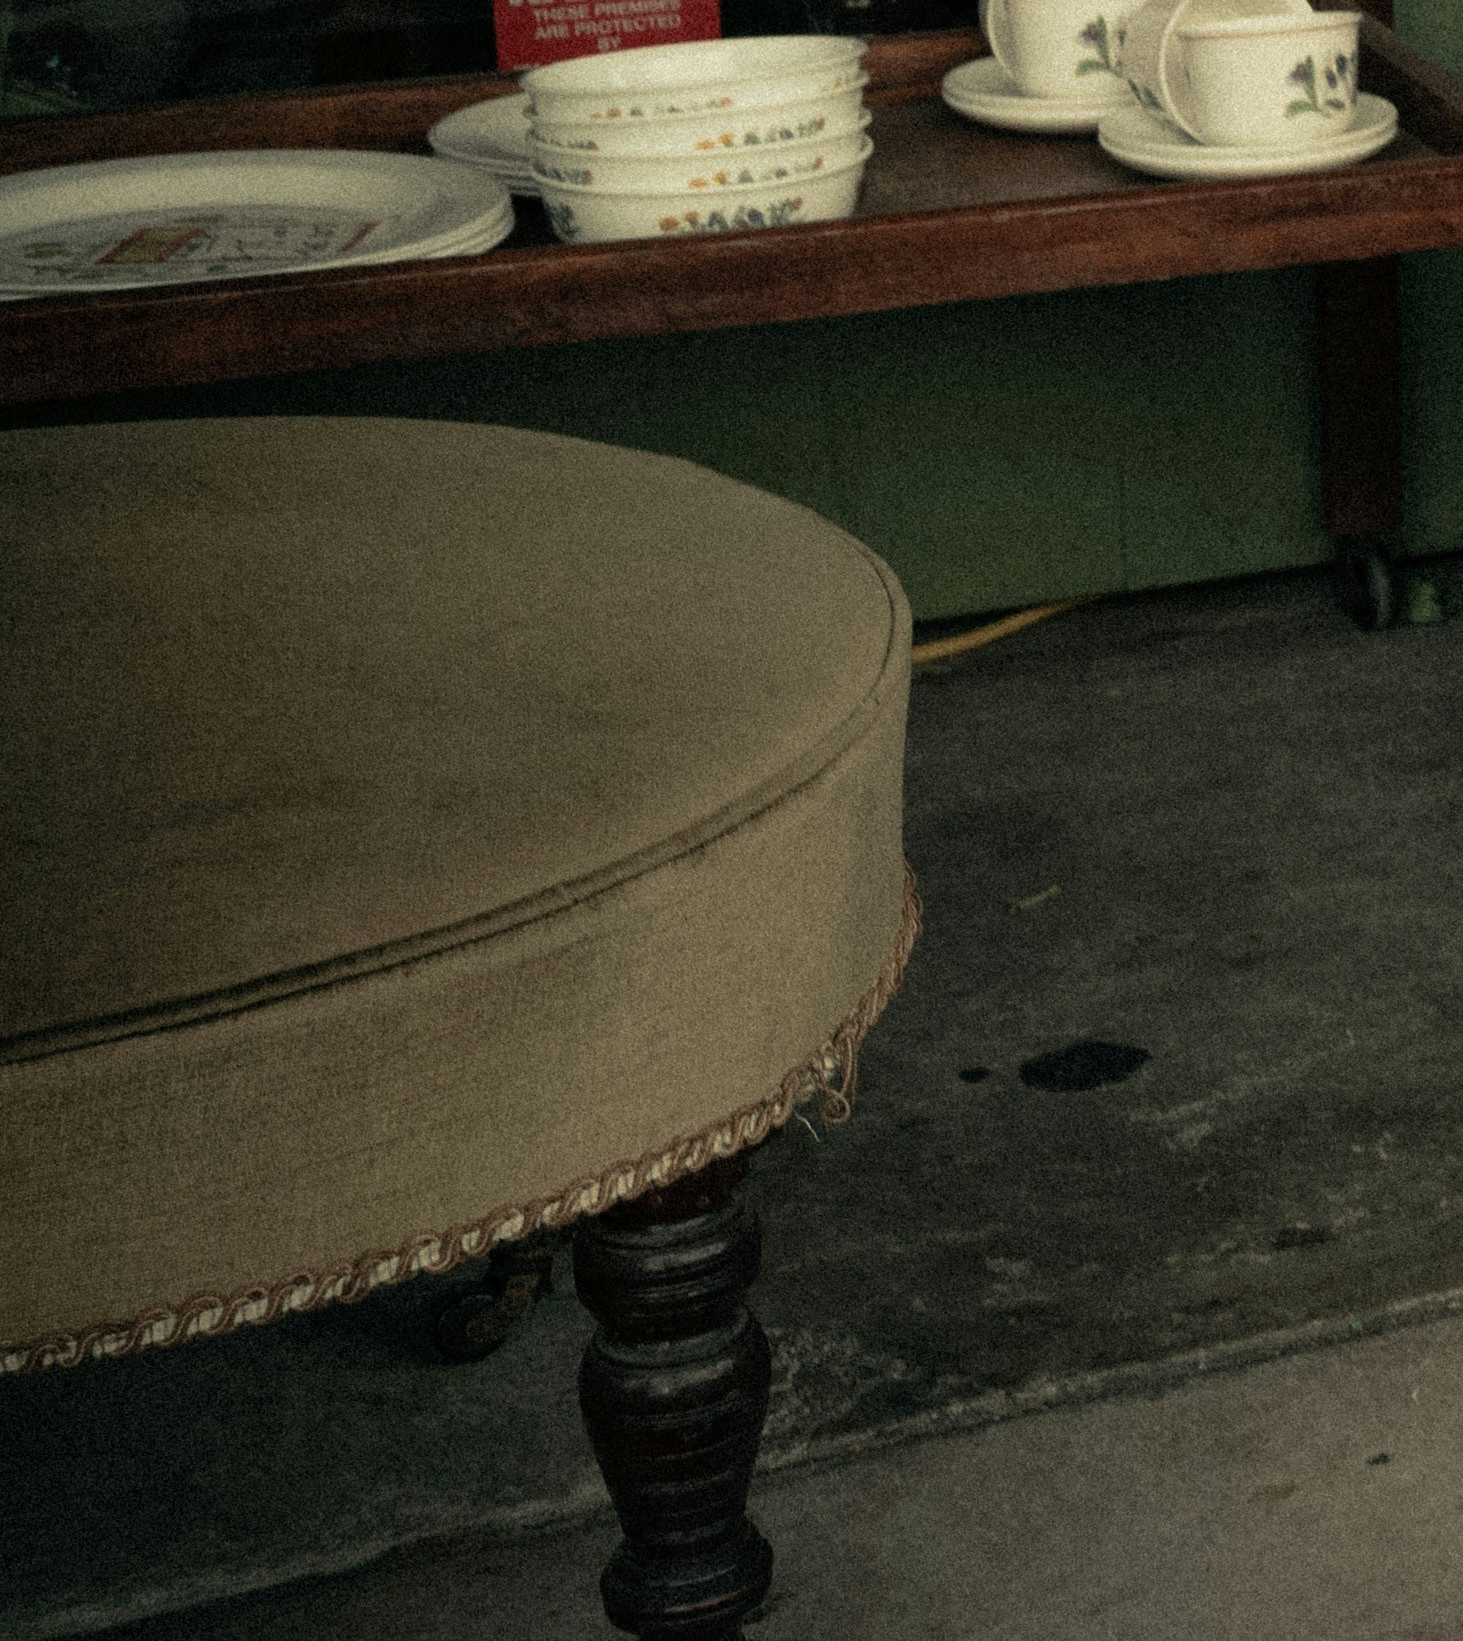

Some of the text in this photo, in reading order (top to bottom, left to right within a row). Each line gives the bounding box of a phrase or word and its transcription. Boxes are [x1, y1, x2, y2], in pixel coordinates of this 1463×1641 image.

[534, 3, 592, 22] THESE
[535, 14, 682, 40] ARE PROTECTED
[597, 35, 623, 52] BY
